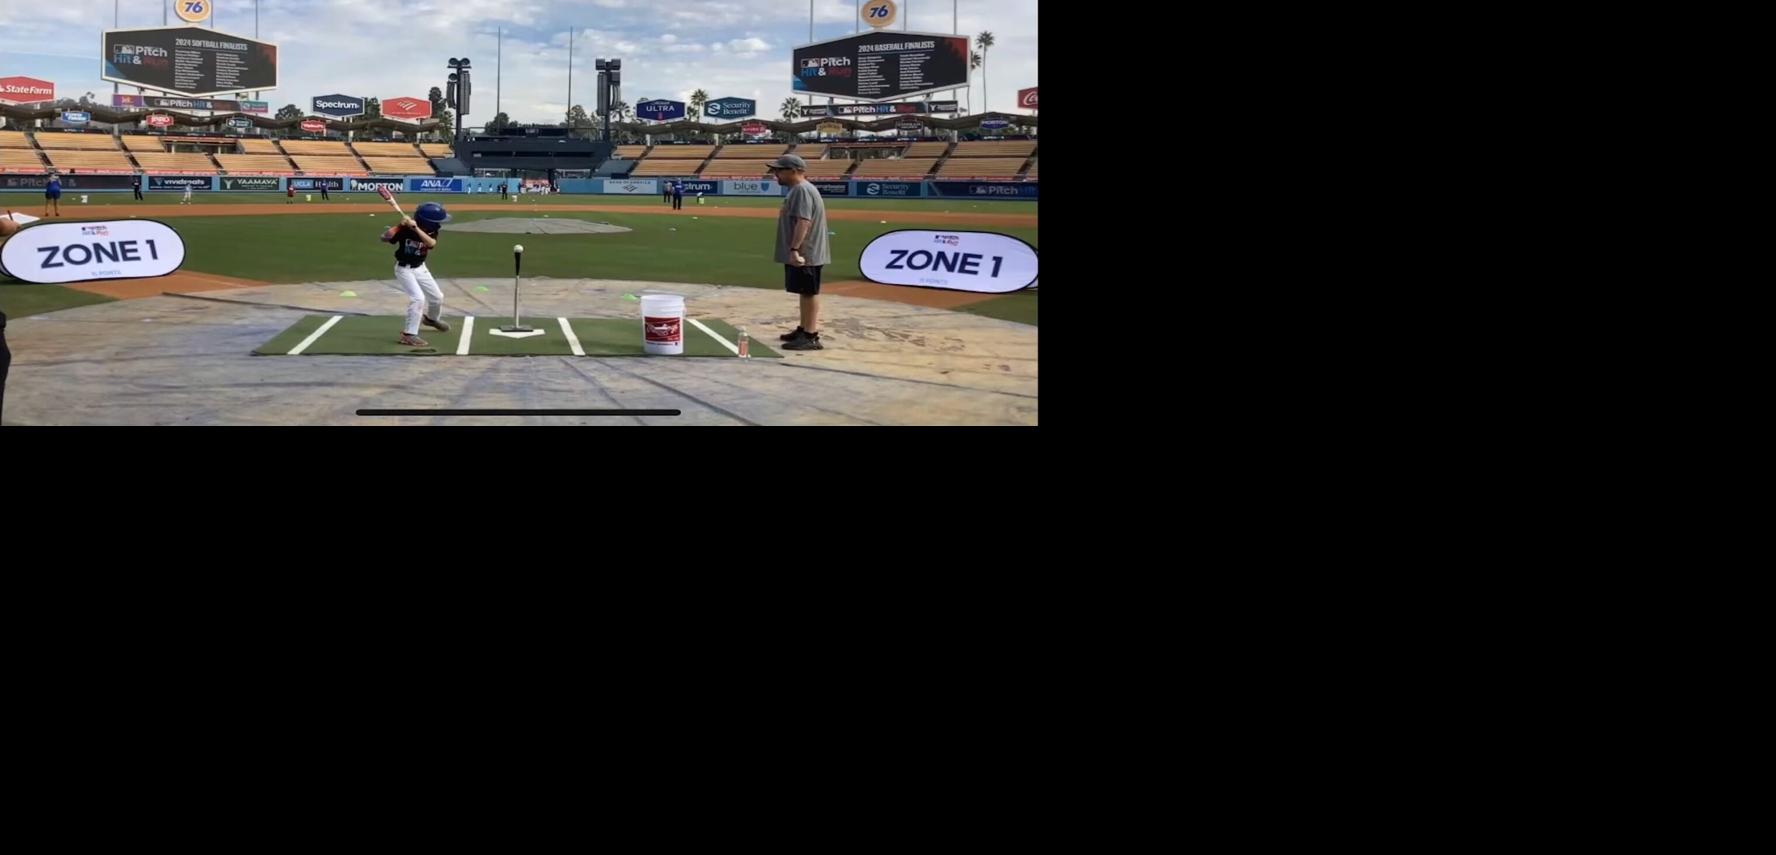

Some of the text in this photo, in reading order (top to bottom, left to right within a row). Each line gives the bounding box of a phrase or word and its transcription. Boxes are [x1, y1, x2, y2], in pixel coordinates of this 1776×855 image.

[185, 2, 203, 13] 76
[870, 6, 888, 18] 76
[176, 38, 248, 51] 2024 SOFTBALL FINALISTS
[858, 41, 935, 53] 2024 BASEBALL FINALISTS
[135, 45, 168, 57] Pitch
[133, 55, 142, 65] &
[820, 57, 851, 67] Pitch
[801, 67, 817, 77] Hit
[818, 67, 827, 77] &
[170, 100, 192, 109] Pitch
[316, 99, 358, 110] Spectrum
[723, 102, 751, 110] Security
[854, 105, 876, 114] Pitch
[421, 179, 441, 188] ANA
[734, 181, 758, 192] blue
[988, 185, 1018, 195] Pitch
[37, 239, 158, 269] ZONE 1
[885, 249, 1003, 278] ZONE 1
